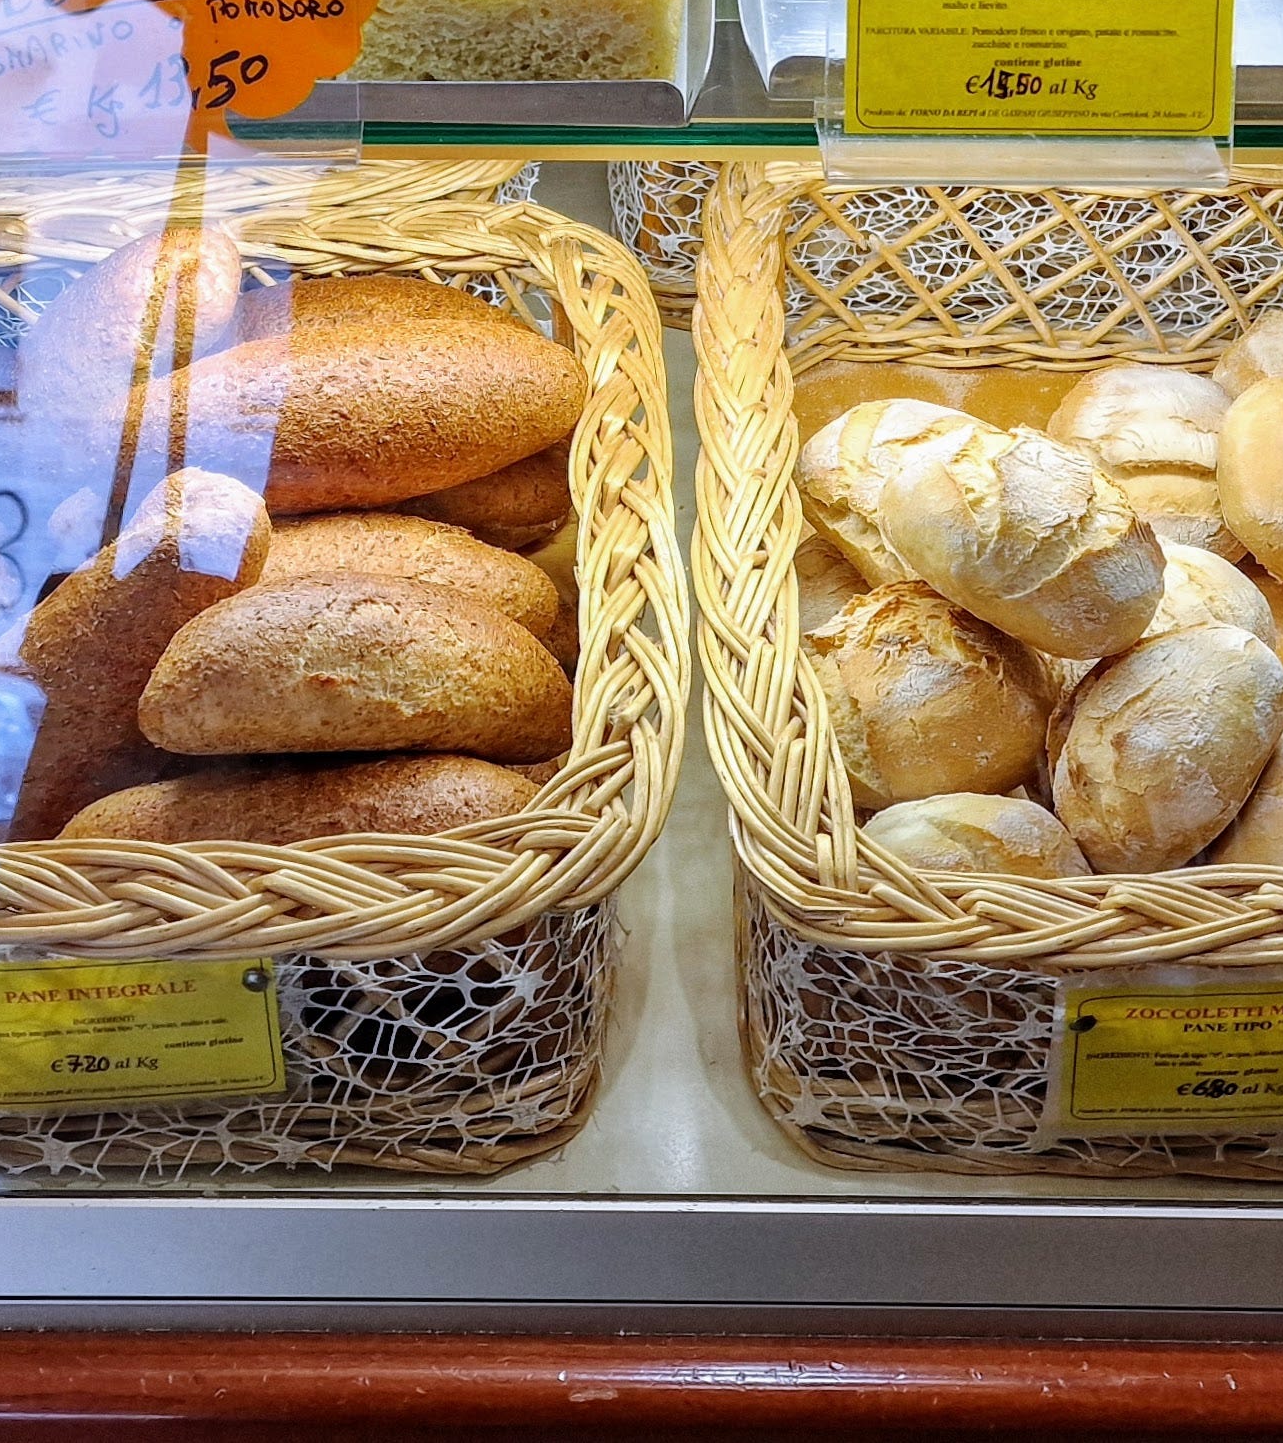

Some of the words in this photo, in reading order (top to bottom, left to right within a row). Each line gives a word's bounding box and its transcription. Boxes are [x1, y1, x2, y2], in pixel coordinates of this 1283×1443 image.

[994, 58, 1041, 67] contiene
[1044, 57, 1082, 68] glutine
[22, 88, 60, 125] €
[138, 50, 269, 110] 13,50
[1049, 78, 1067, 94] al
[1073, 79, 1100, 101] Kg
[5, 989, 63, 1005] PANE
[68, 978, 198, 1002] INTEGRALE
[1125, 1004, 1265, 1021] ZOCCOLETTI
[1183, 1021, 1227, 1034] PANE
[1232, 1019, 1272, 1032] TIPO
[115, 1056, 133, 1070] al
[135, 1055, 159, 1071] Kg
[1242, 1083, 1261, 1095] al
